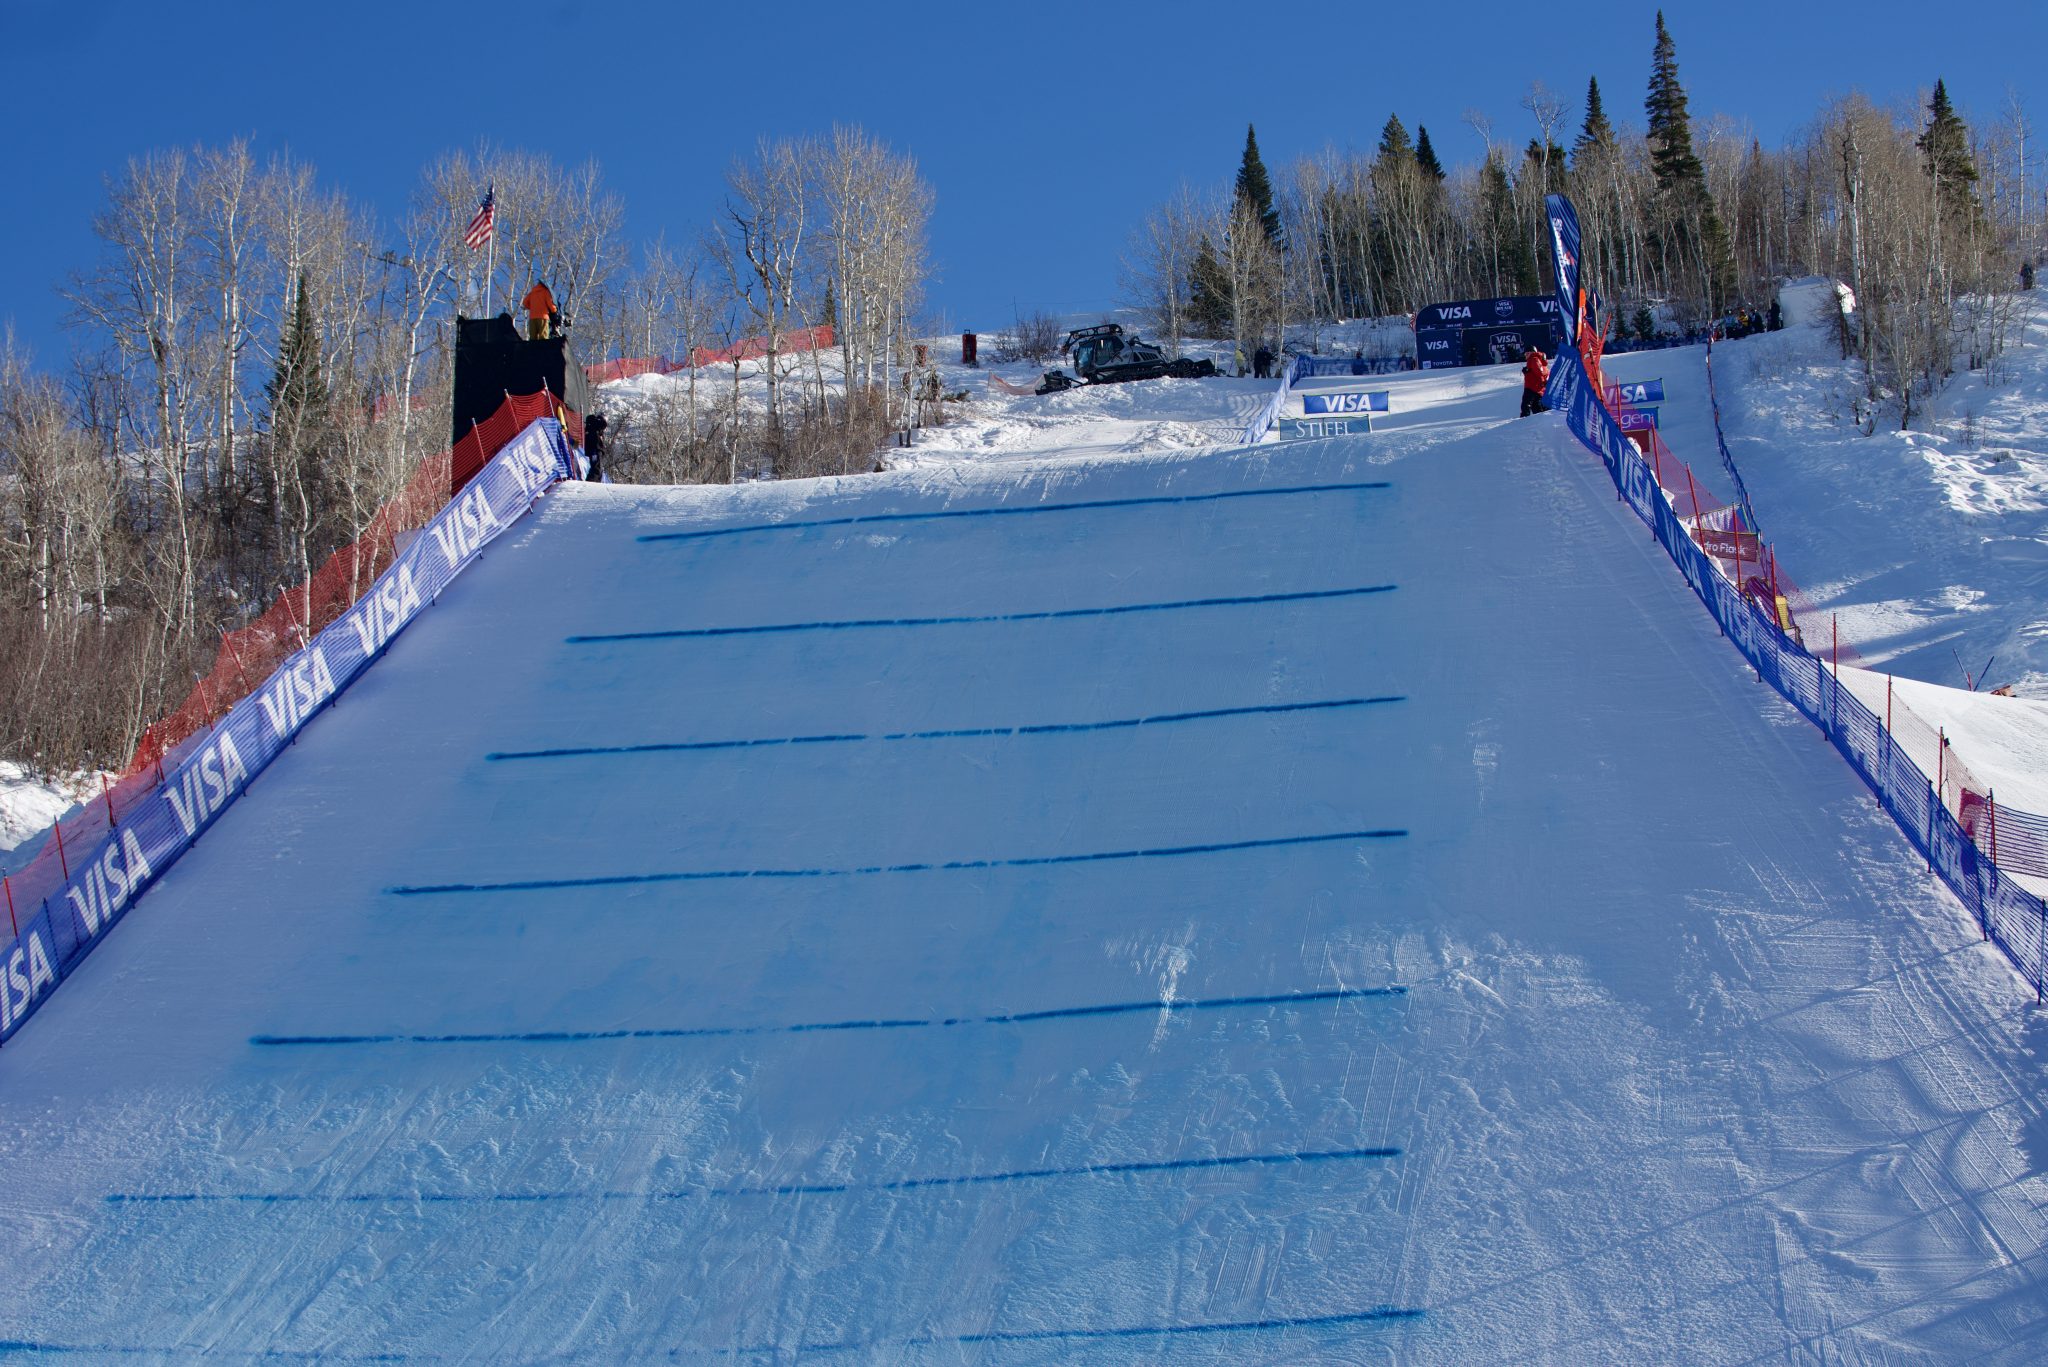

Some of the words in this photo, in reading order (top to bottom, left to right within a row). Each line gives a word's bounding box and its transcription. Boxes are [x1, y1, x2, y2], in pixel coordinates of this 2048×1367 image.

[1437, 306, 1472, 320] VISA
[1496, 335, 1517, 343] VISA
[1537, 300, 1558, 313] VI
[1425, 341, 1449, 350] VISA
[1296, 420, 1353, 438] STIFEL
[1320, 394, 1371, 412] VISA
[1603, 385, 1647, 404] VISA
[501, 426, 556, 496] VISA
[1616, 437, 1657, 527] VISA
[430, 484, 499, 569] VISA
[1660, 503, 1706, 600] VISA
[349, 563, 421, 657] VISA
[257, 647, 335, 741] VISA
[163, 730, 247, 836] VISA
[66, 828, 151, 938] VISA
[0, 930, 54, 1032] ISA
